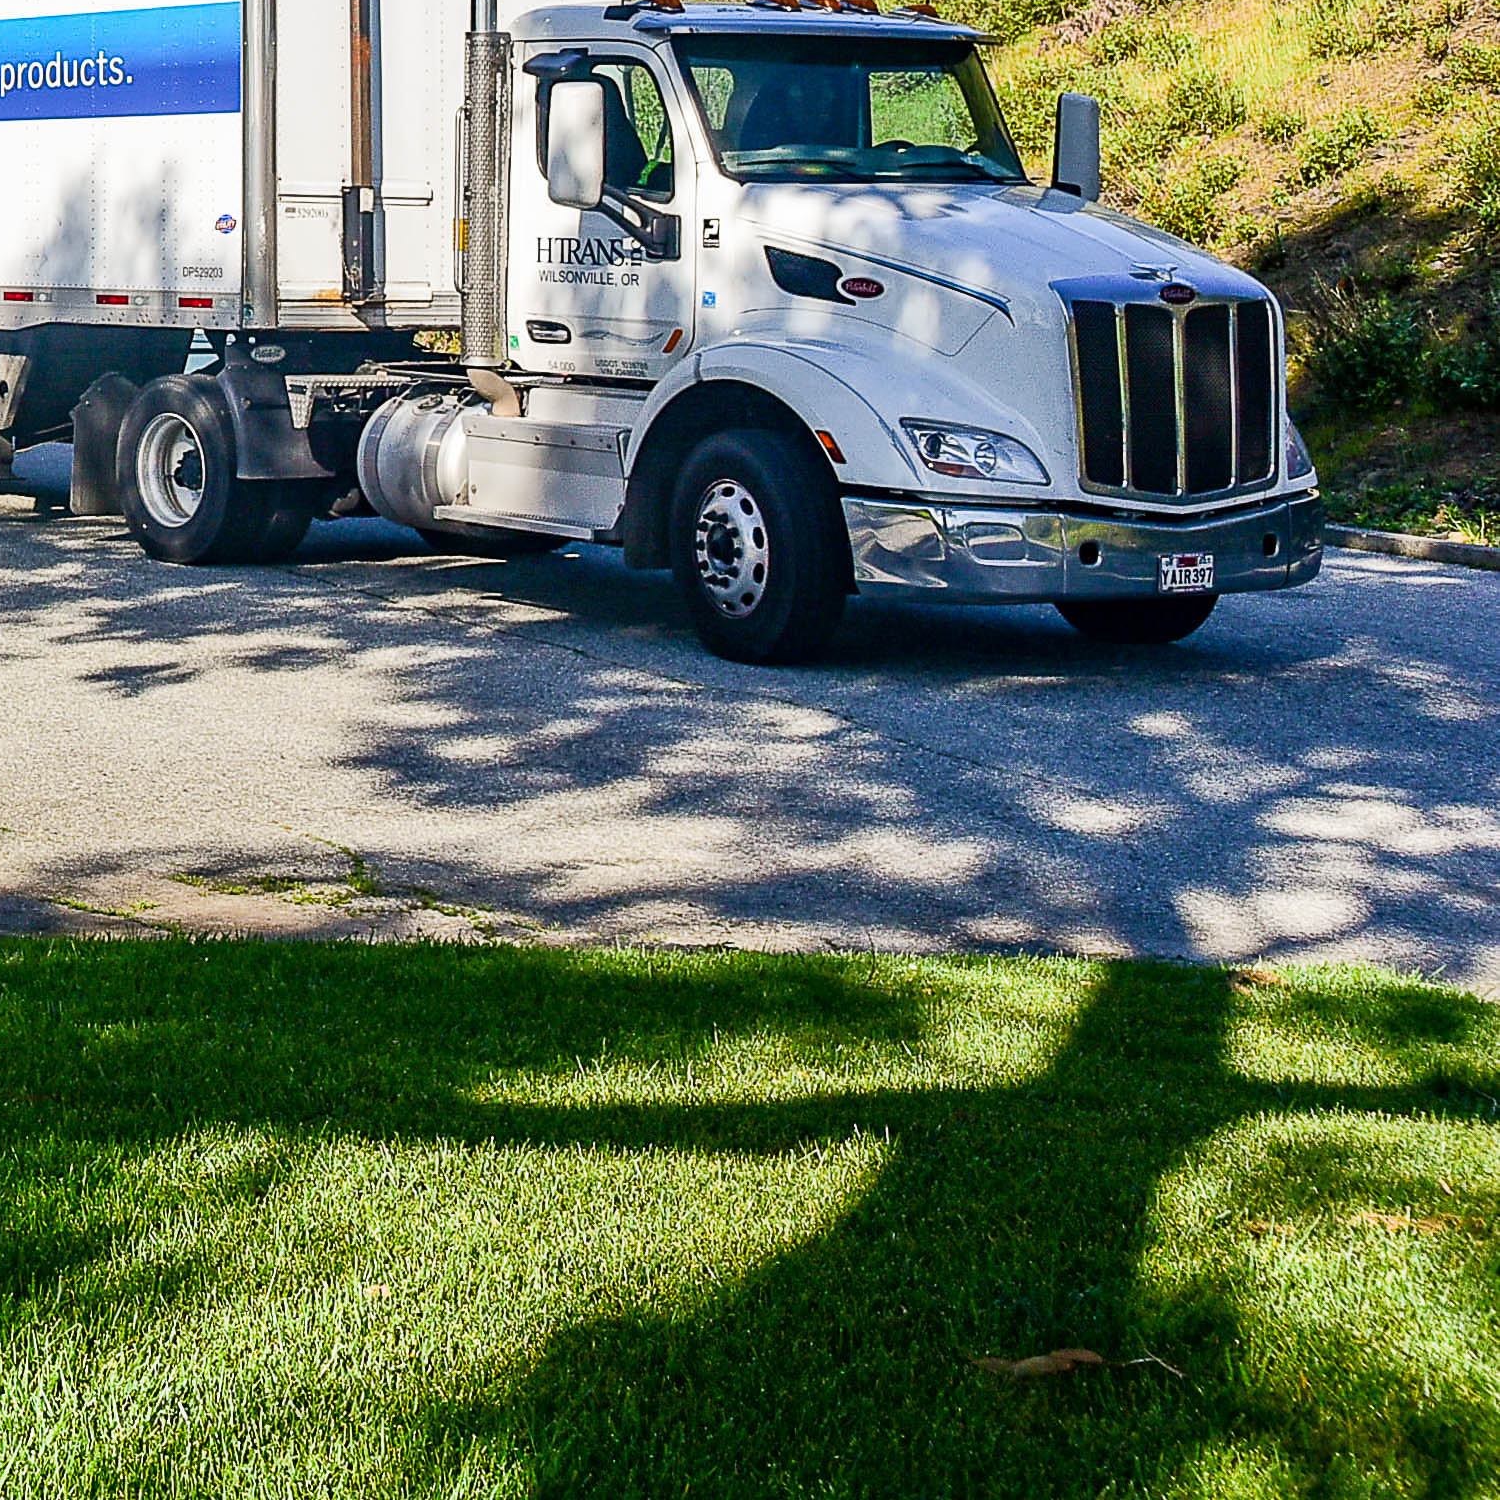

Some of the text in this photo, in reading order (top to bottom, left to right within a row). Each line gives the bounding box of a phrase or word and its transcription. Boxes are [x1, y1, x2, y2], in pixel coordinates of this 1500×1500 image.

[0, 49, 133, 97] products.
[539, 270, 640, 286] WILSONVILLE, OR
